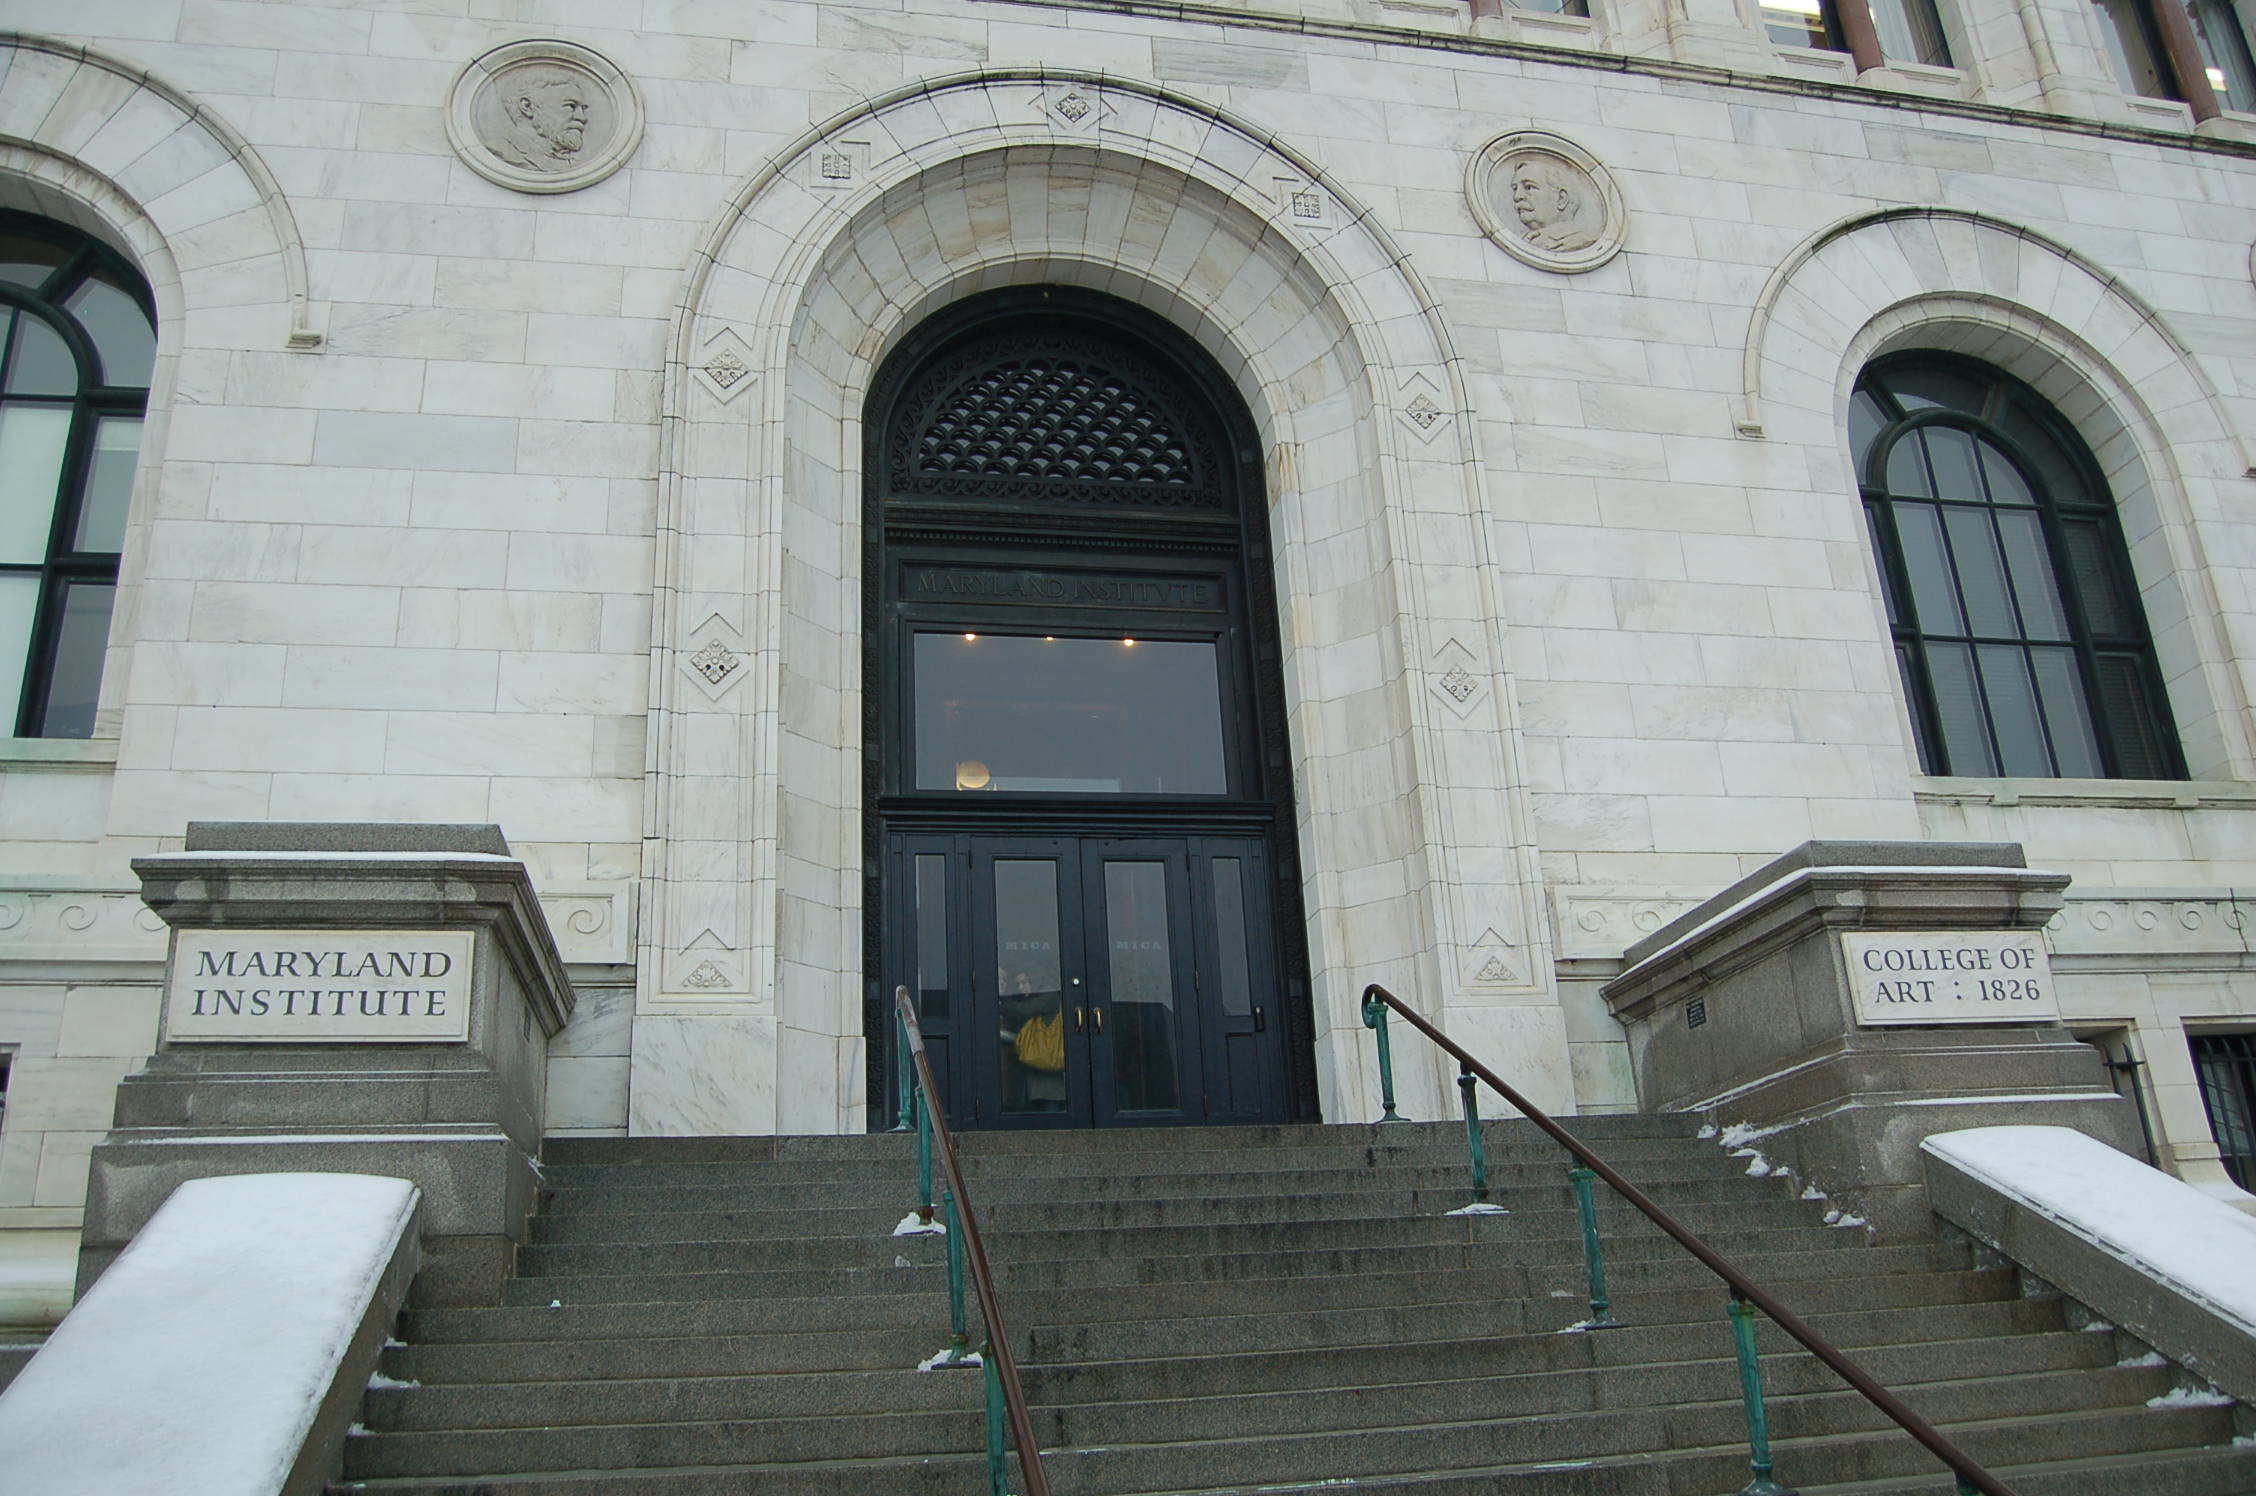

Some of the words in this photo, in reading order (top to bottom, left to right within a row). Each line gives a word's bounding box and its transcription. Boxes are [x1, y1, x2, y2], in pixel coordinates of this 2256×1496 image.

[917, 571, 1064, 599] MARYLAND
[194, 950, 453, 979] MARYLAND
[1863, 948, 1992, 971] COLLEGE
[2000, 947, 2035, 970] OF
[191, 989, 447, 1017] INSTITUTE
[1874, 980, 1935, 1003] ART
[1978, 979, 2040, 1001] 1826
